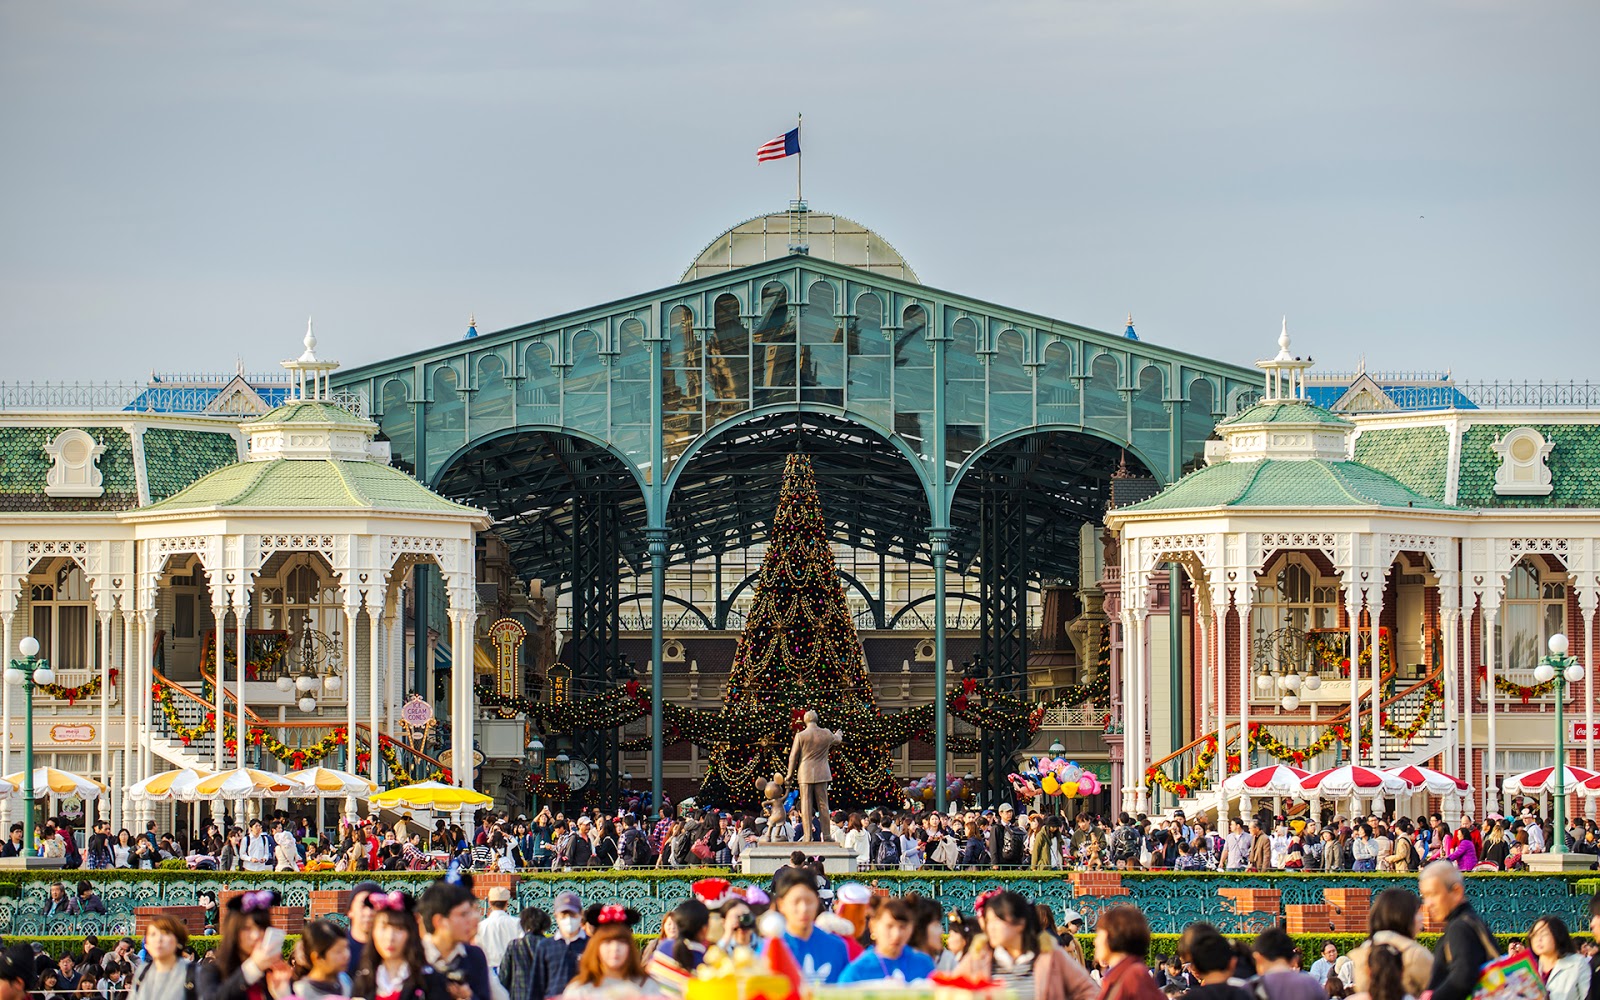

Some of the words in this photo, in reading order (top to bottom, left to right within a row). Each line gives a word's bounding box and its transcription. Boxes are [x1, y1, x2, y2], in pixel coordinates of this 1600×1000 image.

[496, 623, 519, 634] PENNY
[503, 631, 512, 698] ARCAD
[555, 676, 563, 704] EMPO
